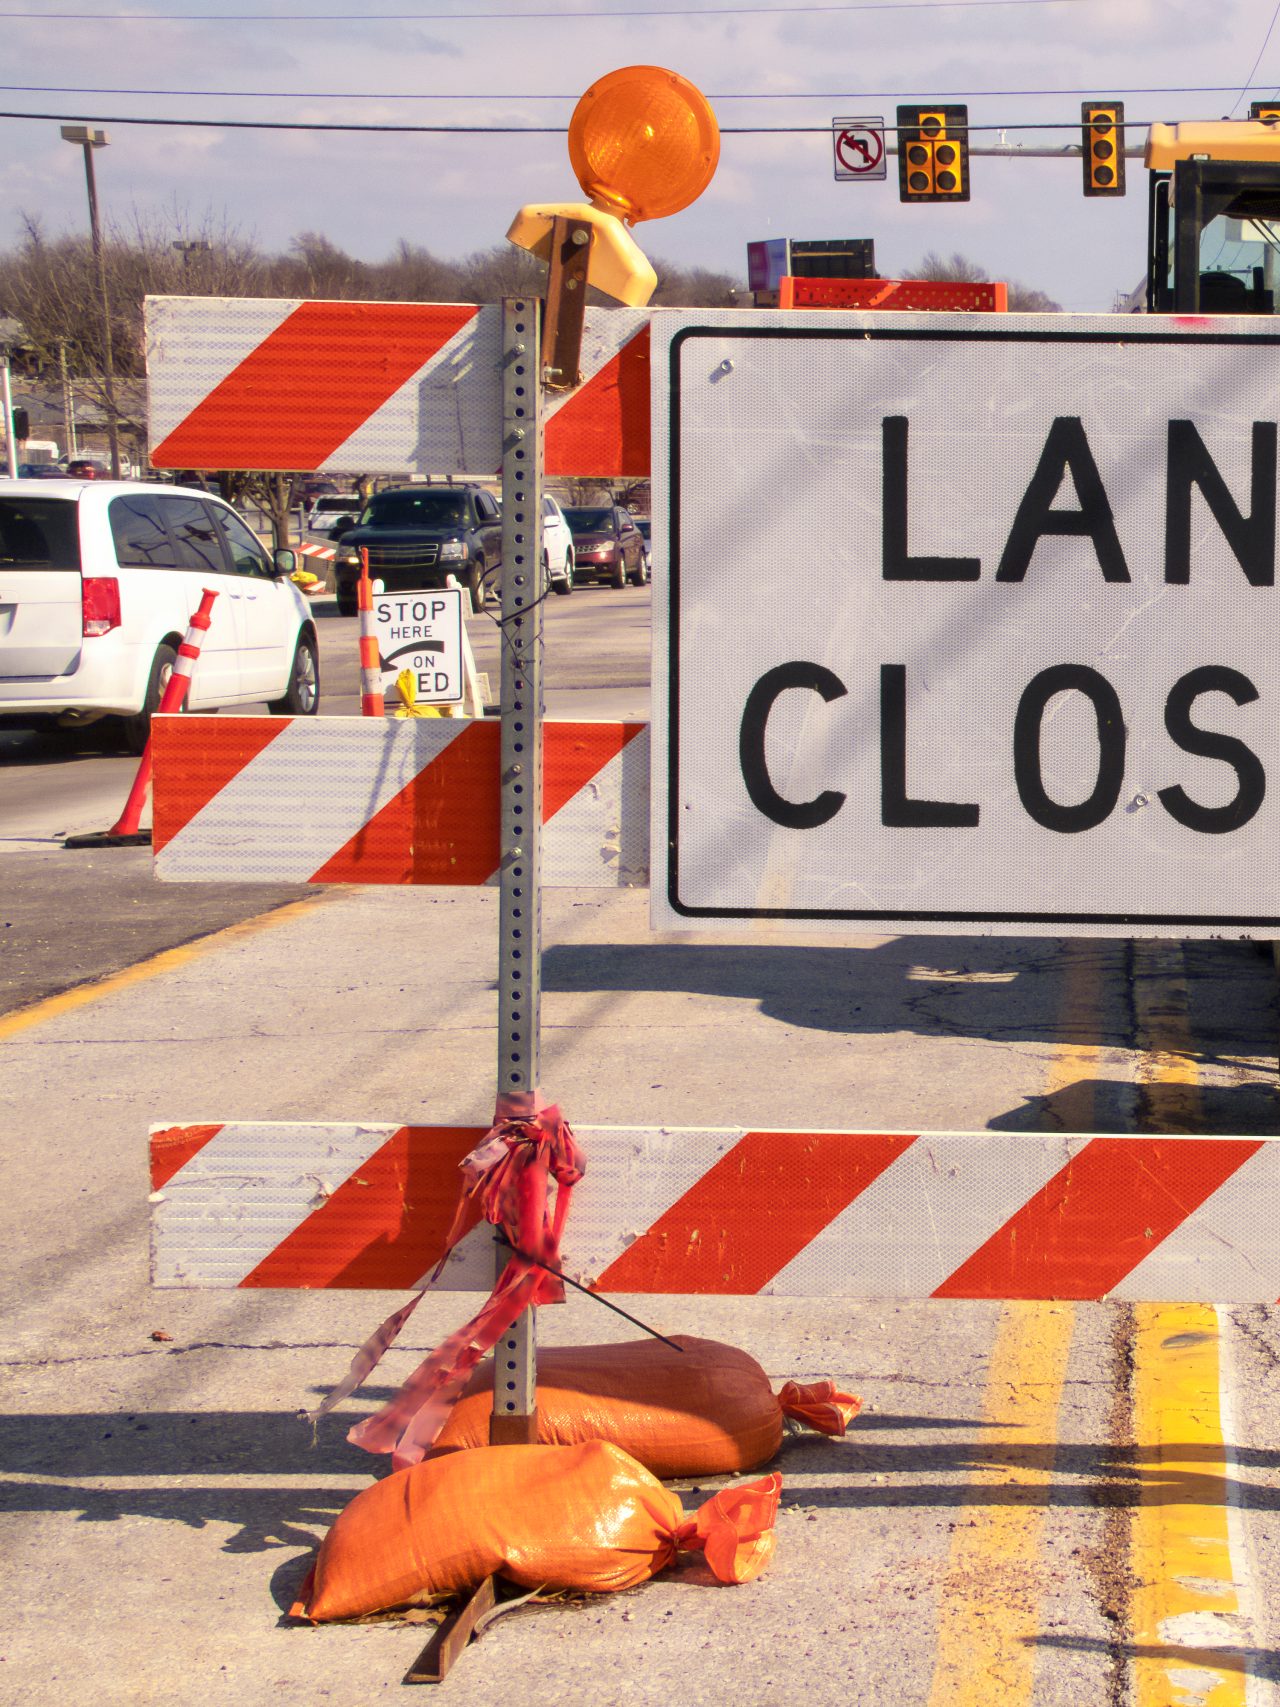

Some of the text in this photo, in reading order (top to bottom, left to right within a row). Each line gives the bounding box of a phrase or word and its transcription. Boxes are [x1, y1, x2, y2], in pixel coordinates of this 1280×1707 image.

[377, 601, 446, 623] STOP
[390, 625, 433, 639] HERE
[413, 655, 435, 668] ON
[417, 672, 449, 693] ED
